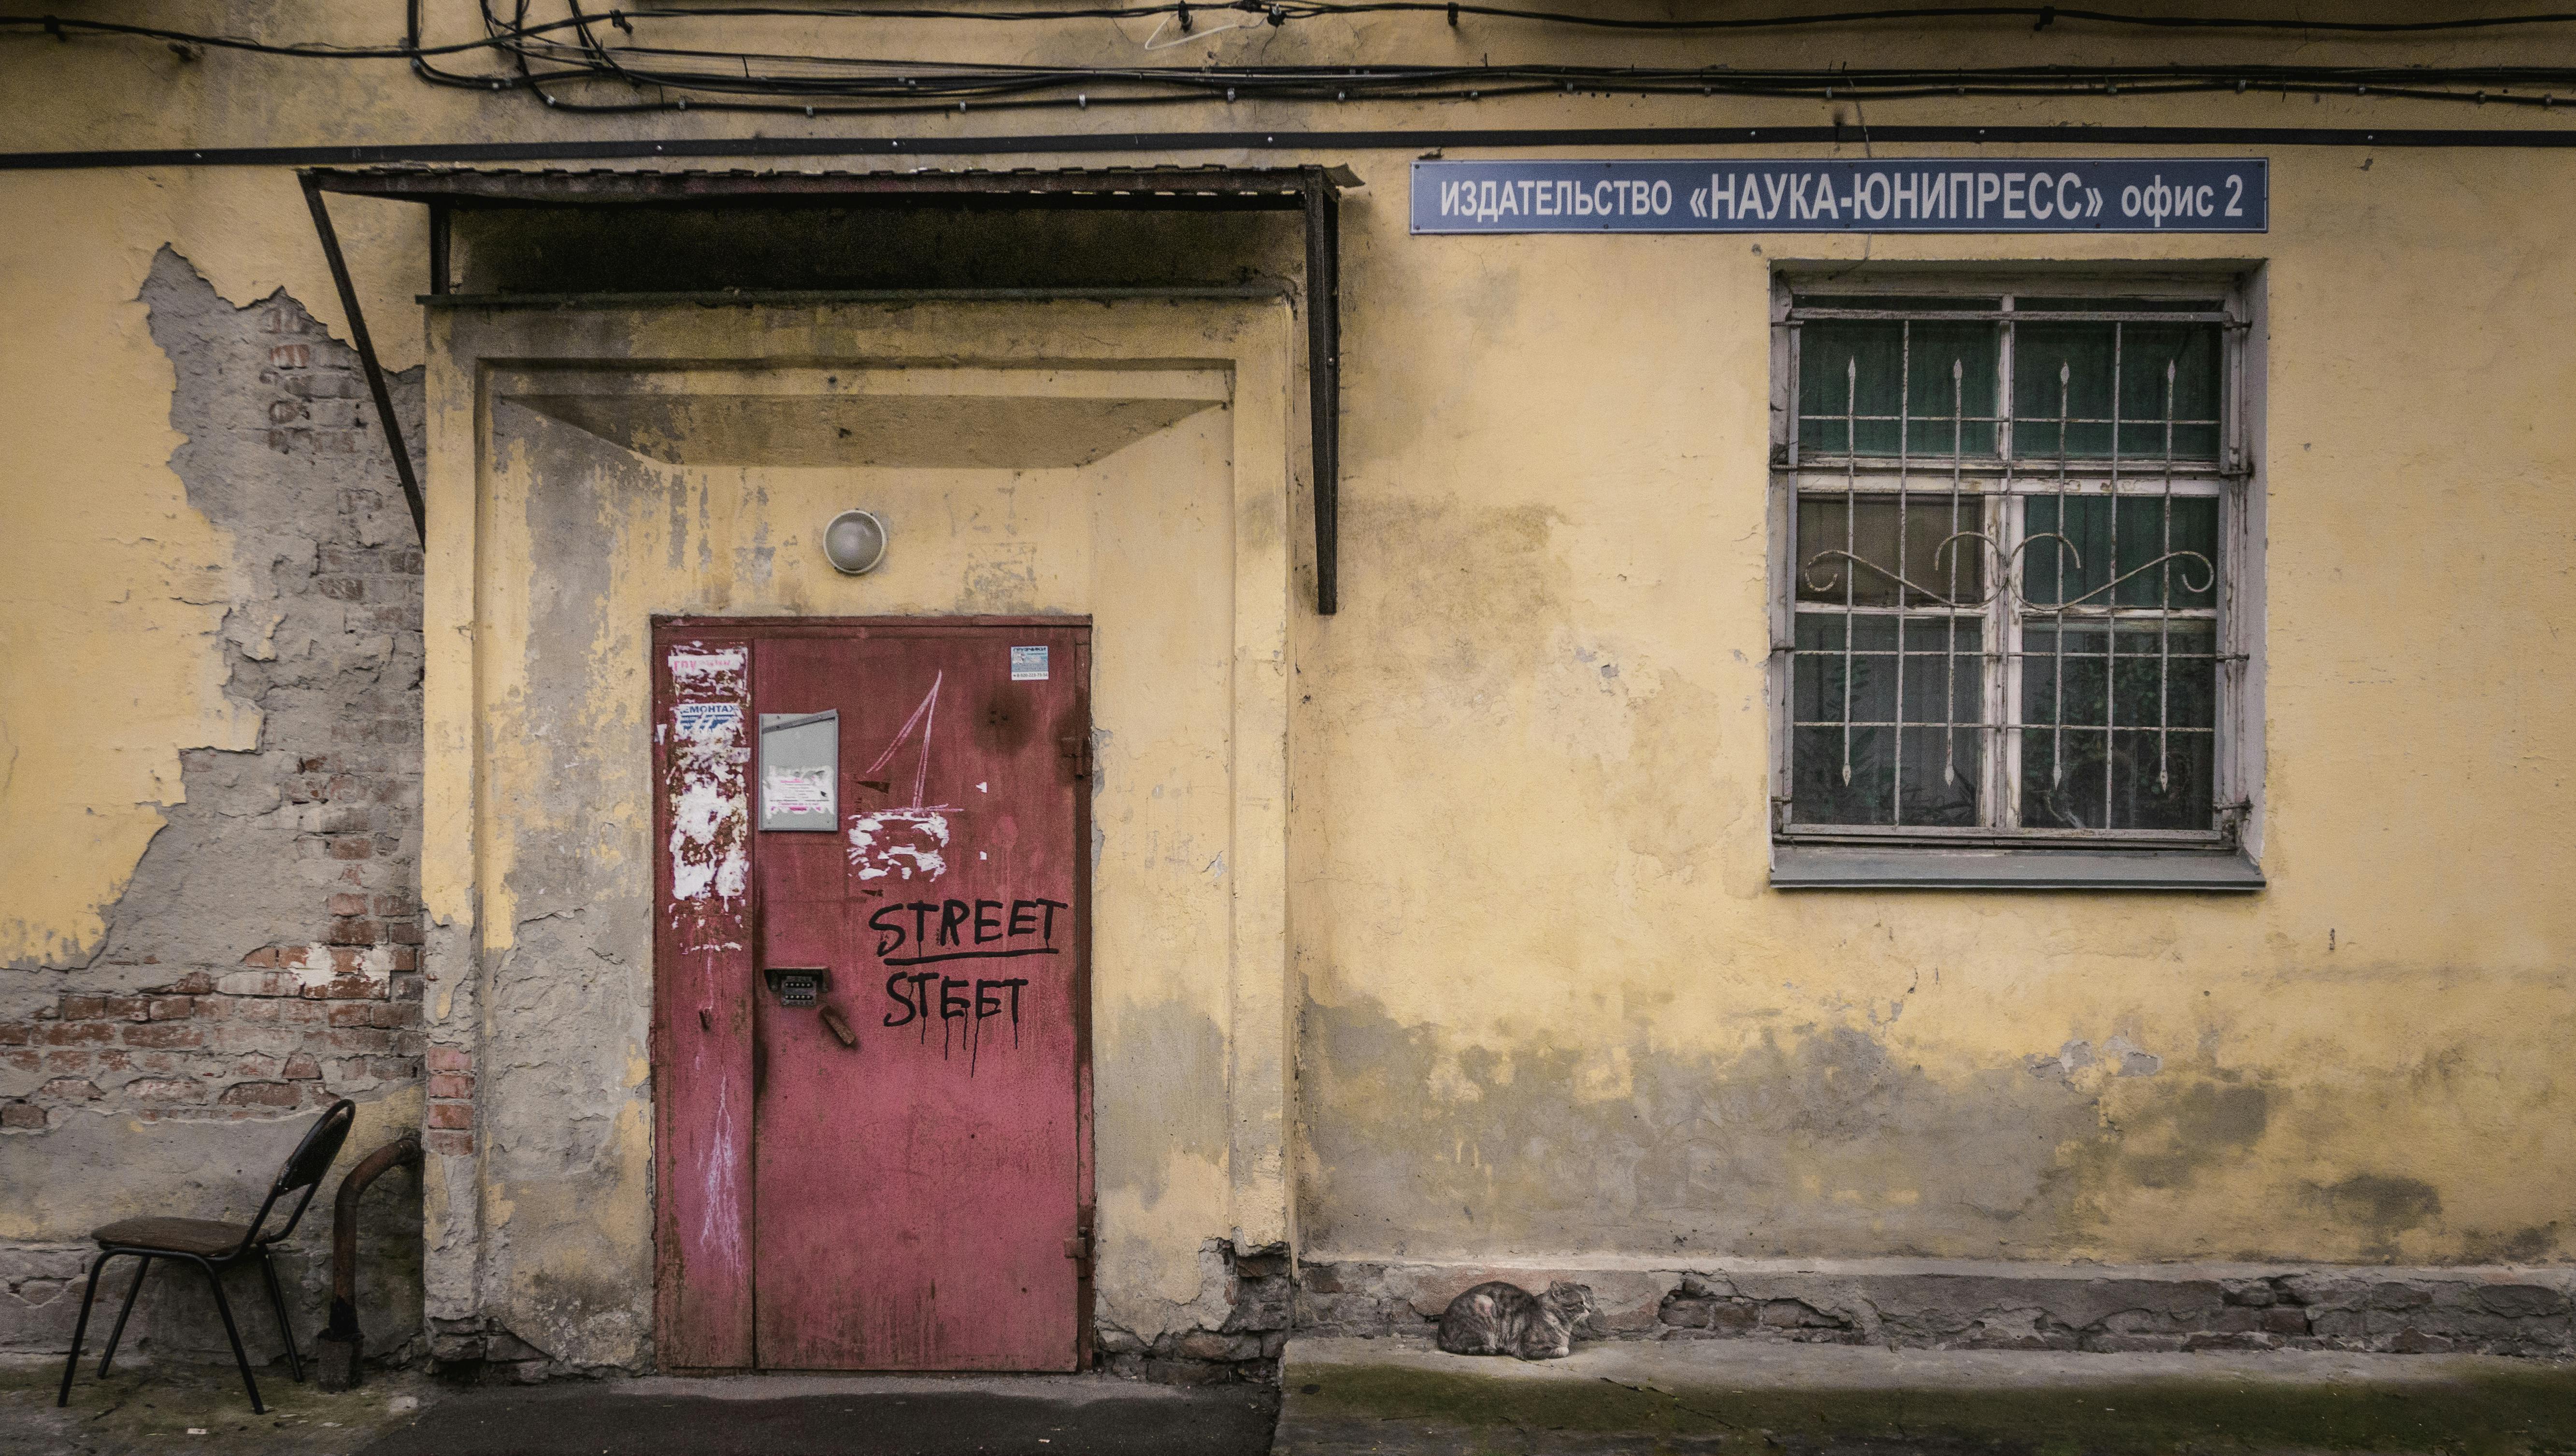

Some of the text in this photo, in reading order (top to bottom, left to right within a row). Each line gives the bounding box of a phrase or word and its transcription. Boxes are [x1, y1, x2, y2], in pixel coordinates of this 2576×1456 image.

[1441, 173, 2242, 227] ИЗДАТЕЛЬСТВО «НАУКА-ЮНИПРЕСС» офис 2
[680, 705, 738, 714] МОНТА
[869, 898, 1068, 957] STREET
[883, 971, 1029, 1027] STEET
